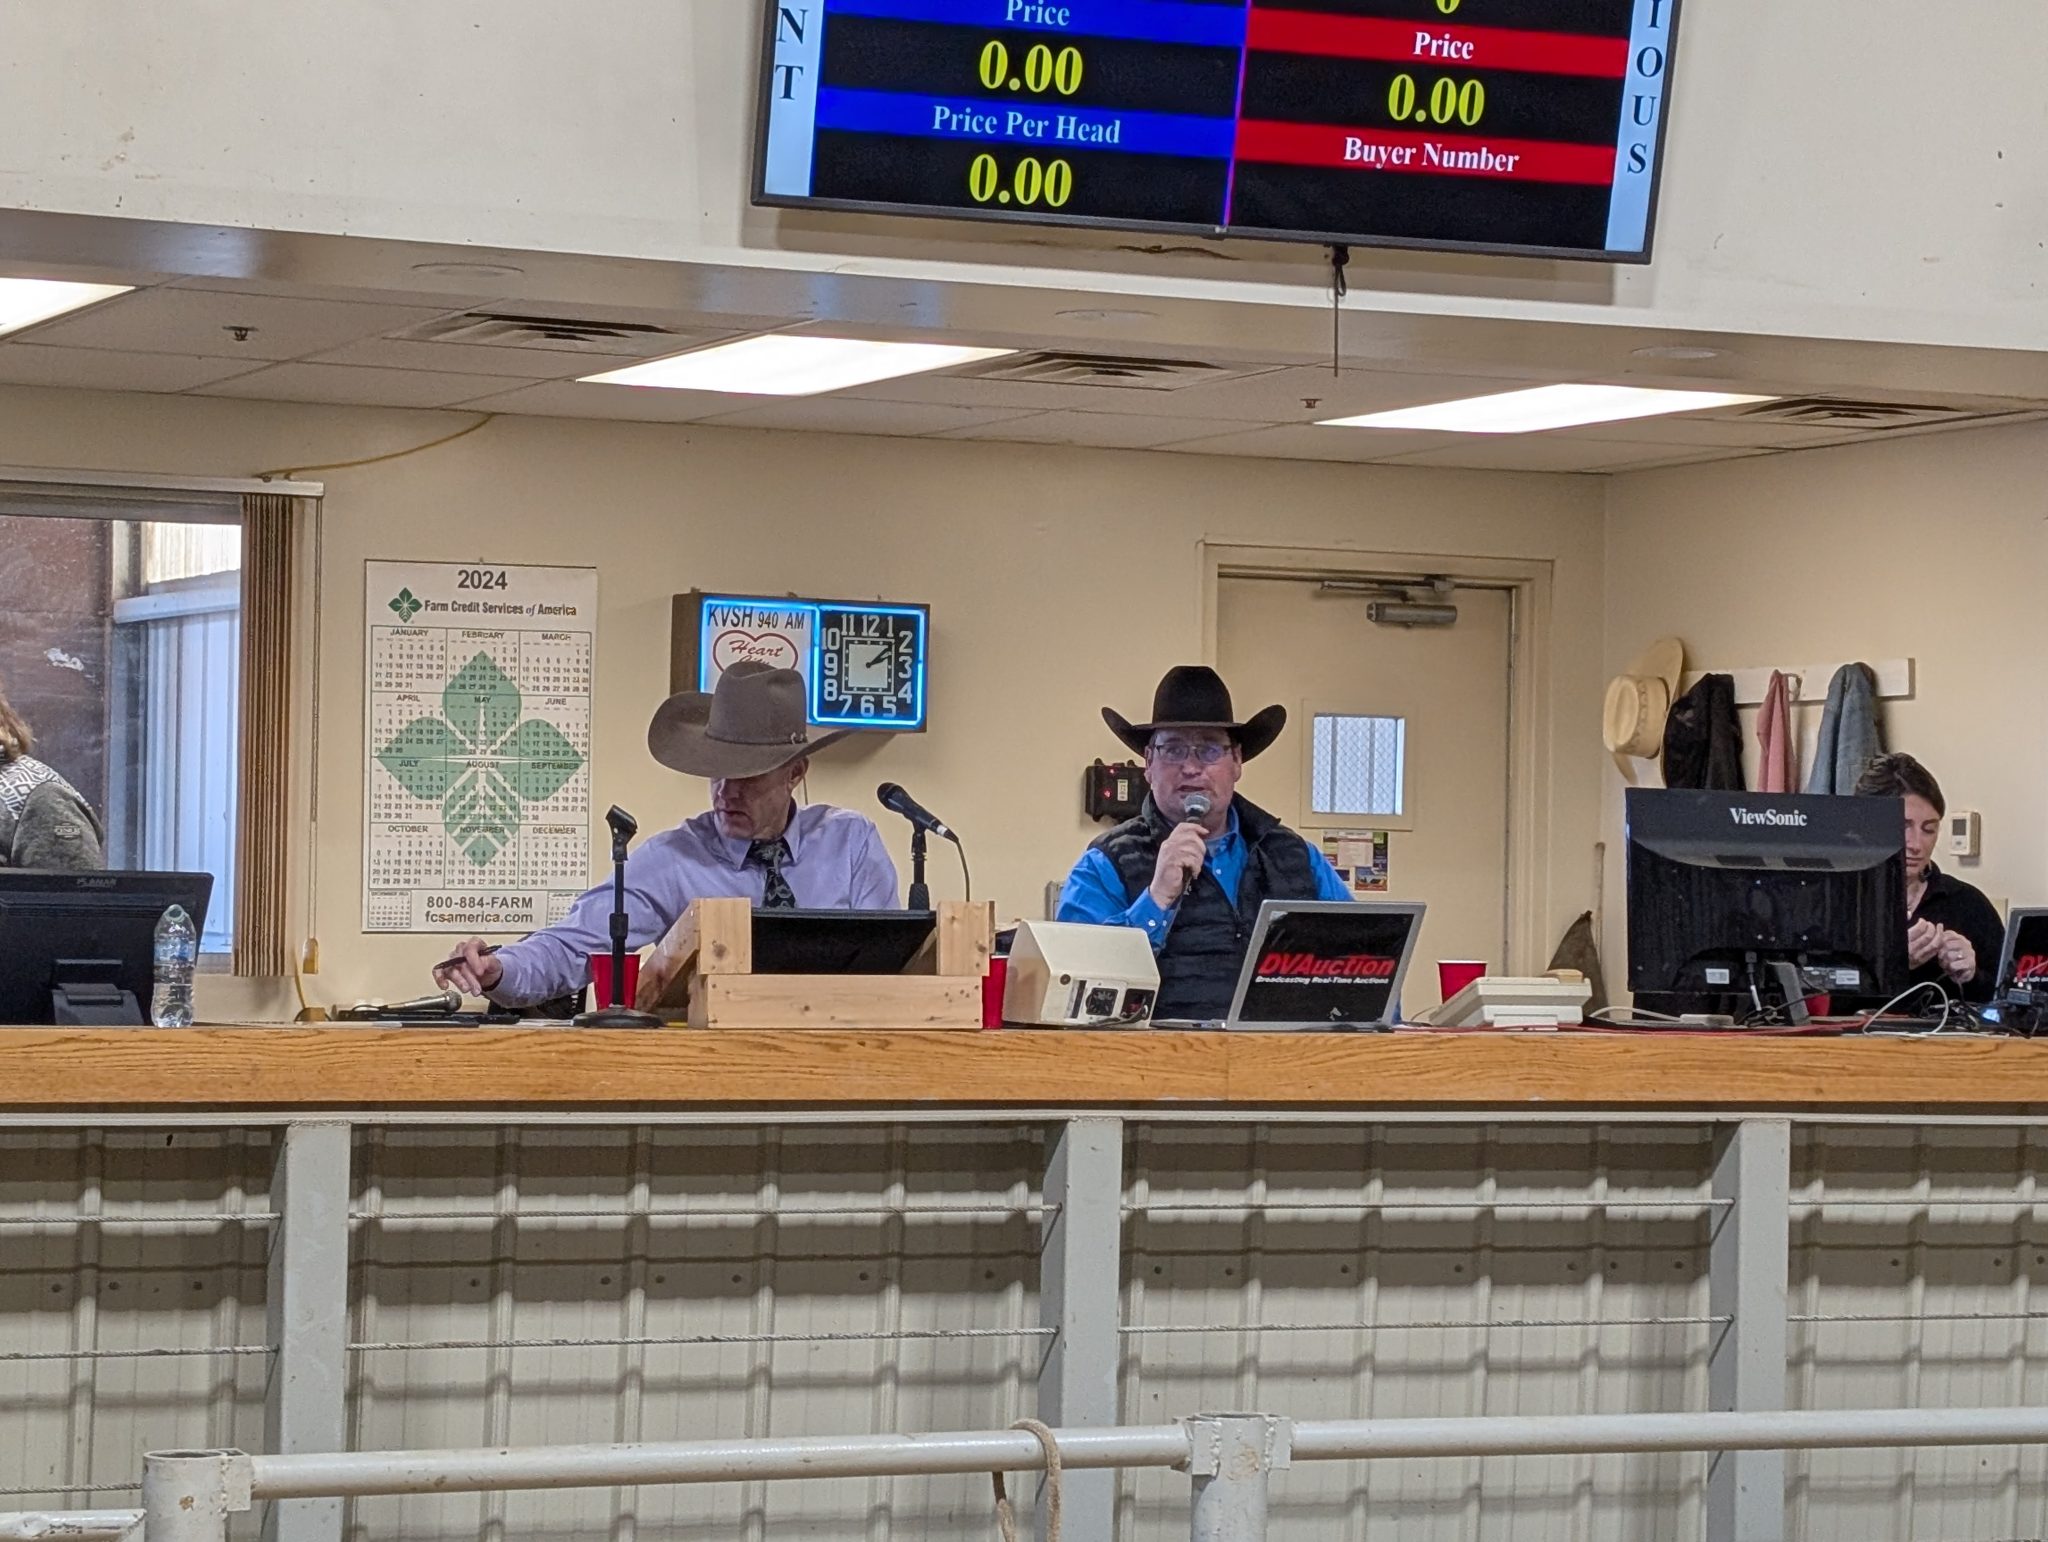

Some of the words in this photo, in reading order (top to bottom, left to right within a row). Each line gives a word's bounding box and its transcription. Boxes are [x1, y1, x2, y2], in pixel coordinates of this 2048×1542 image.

[1005, 0, 1070, 27] Price
[1412, 32, 1474, 60] Price
[979, 40, 1083, 95] 0.00
[1388, 74, 1485, 126] 0.00
[933, 105, 997, 135] Price
[1005, 111, 1050, 139] Per
[1056, 115, 1120, 144] Head
[1344, 137, 1417, 170] Buyer
[1422, 143, 1520, 173] Number
[969, 153, 1072, 207] 0.00
[458, 570, 508, 590] 2024
[425, 600, 448, 612] Farm
[451, 600, 480, 613] Credit
[482, 602, 524, 614] Services
[526, 604, 536, 617] of
[538, 604, 576, 616] America
[708, 606, 754, 628] KVSH
[757, 611, 778, 629] 940
[784, 612, 805, 630] AM
[841, 614, 856, 636] 11
[861, 614, 880, 637] 12
[887, 615, 894, 638] 1
[729, 640, 784, 657] Heart
[821, 628, 840, 650] 10
[899, 630, 913, 653] 2
[824, 653, 838, 676] 9
[898, 656, 912, 678] 3
[824, 678, 838, 701] 8
[898, 681, 912, 704] 4
[839, 694, 852, 716] 7
[860, 695, 874, 717] 6
[883, 696, 896, 717] 5
[1729, 808, 1808, 826] ViewSonic
[426, 896, 533, 908] 800-884-FARM
[425, 910, 533, 923] fcsamerica.com
[1258, 953, 1396, 975] DVAuction
